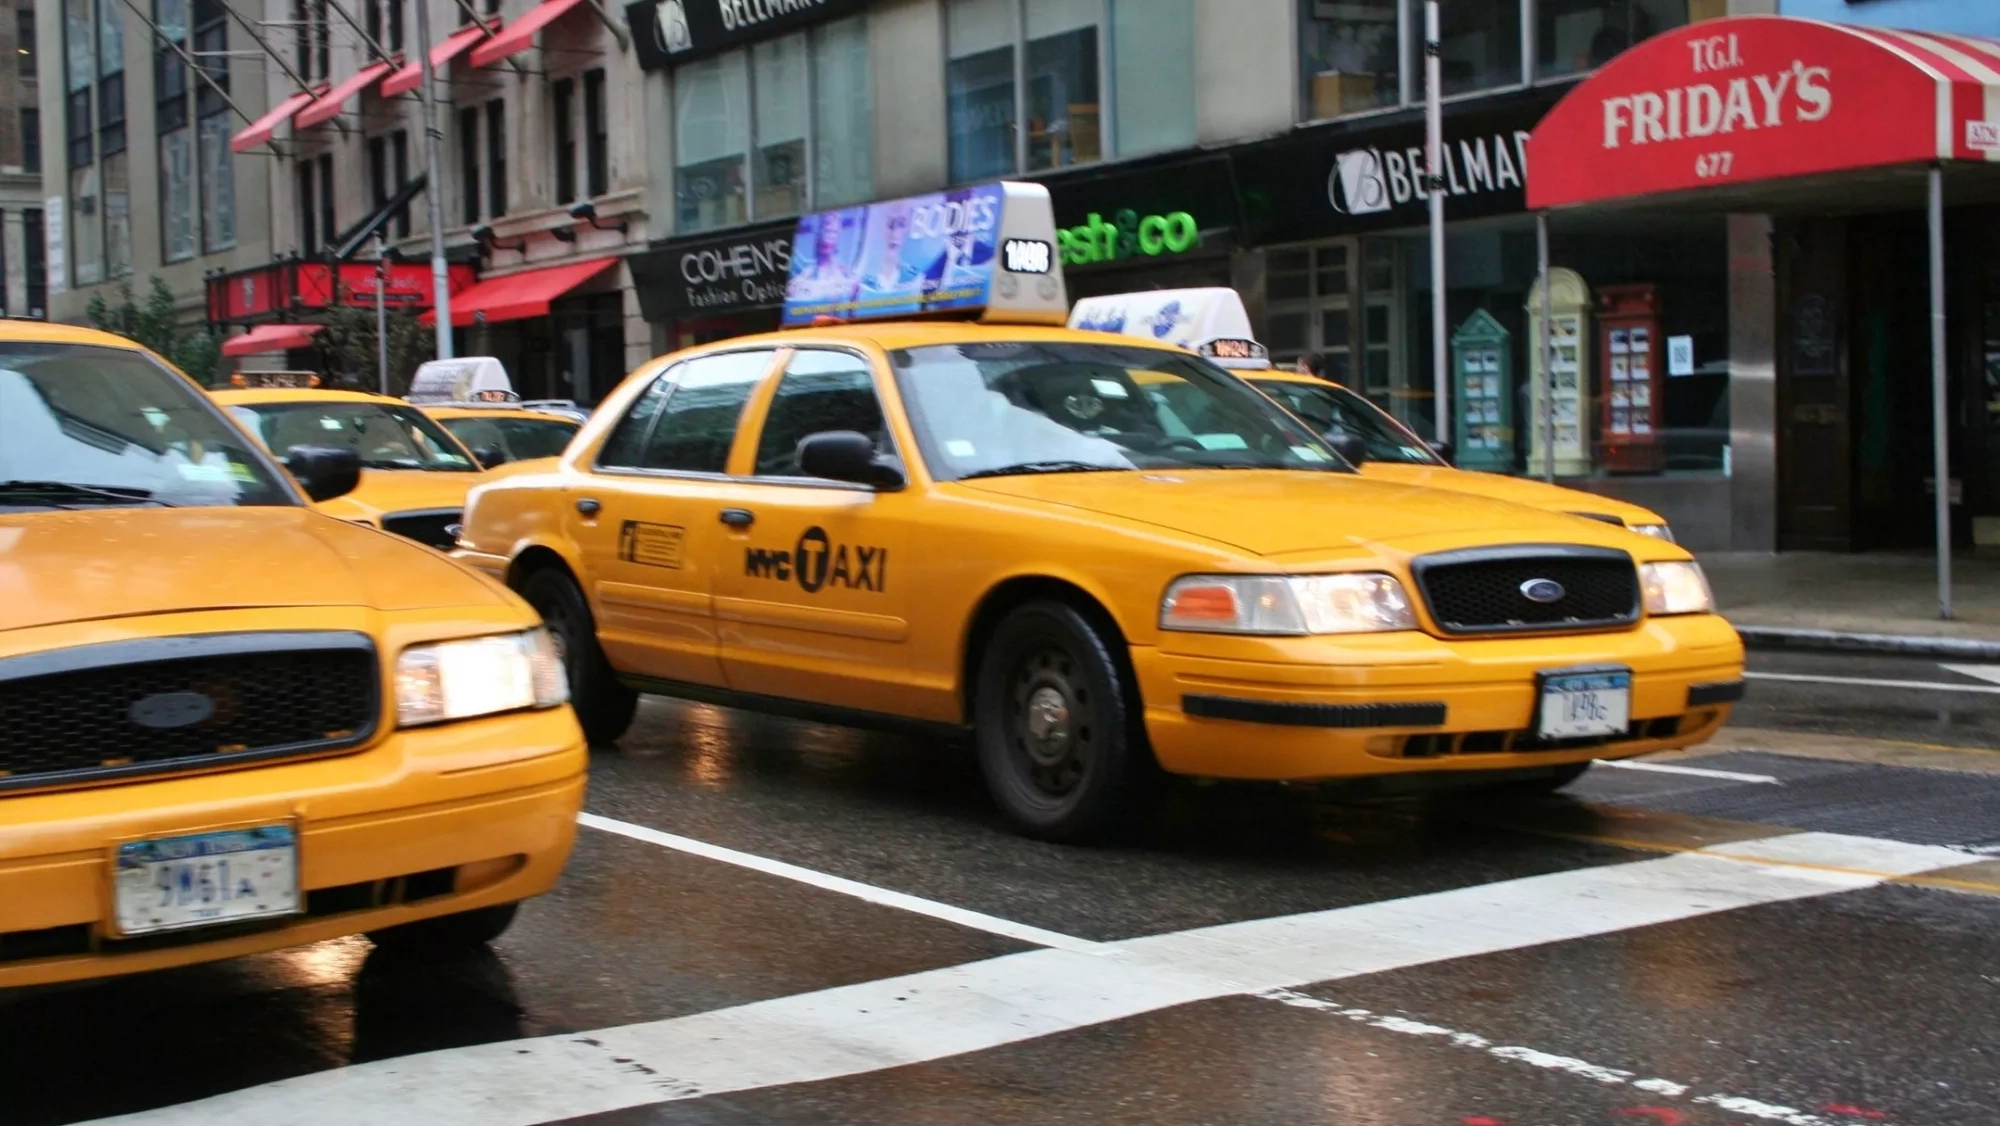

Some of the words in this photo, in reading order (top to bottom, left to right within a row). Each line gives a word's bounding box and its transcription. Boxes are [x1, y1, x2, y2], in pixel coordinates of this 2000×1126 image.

[1602, 59, 1832, 149] FRIDAY'S
[1694, 151, 1734, 178] 677
[908, 195, 999, 240] BODIES
[680, 239, 793, 284] COHEN'S
[685, 286, 739, 307] Fashion
[744, 547, 793, 582] NYC
[796, 526, 887, 593] TAXI
